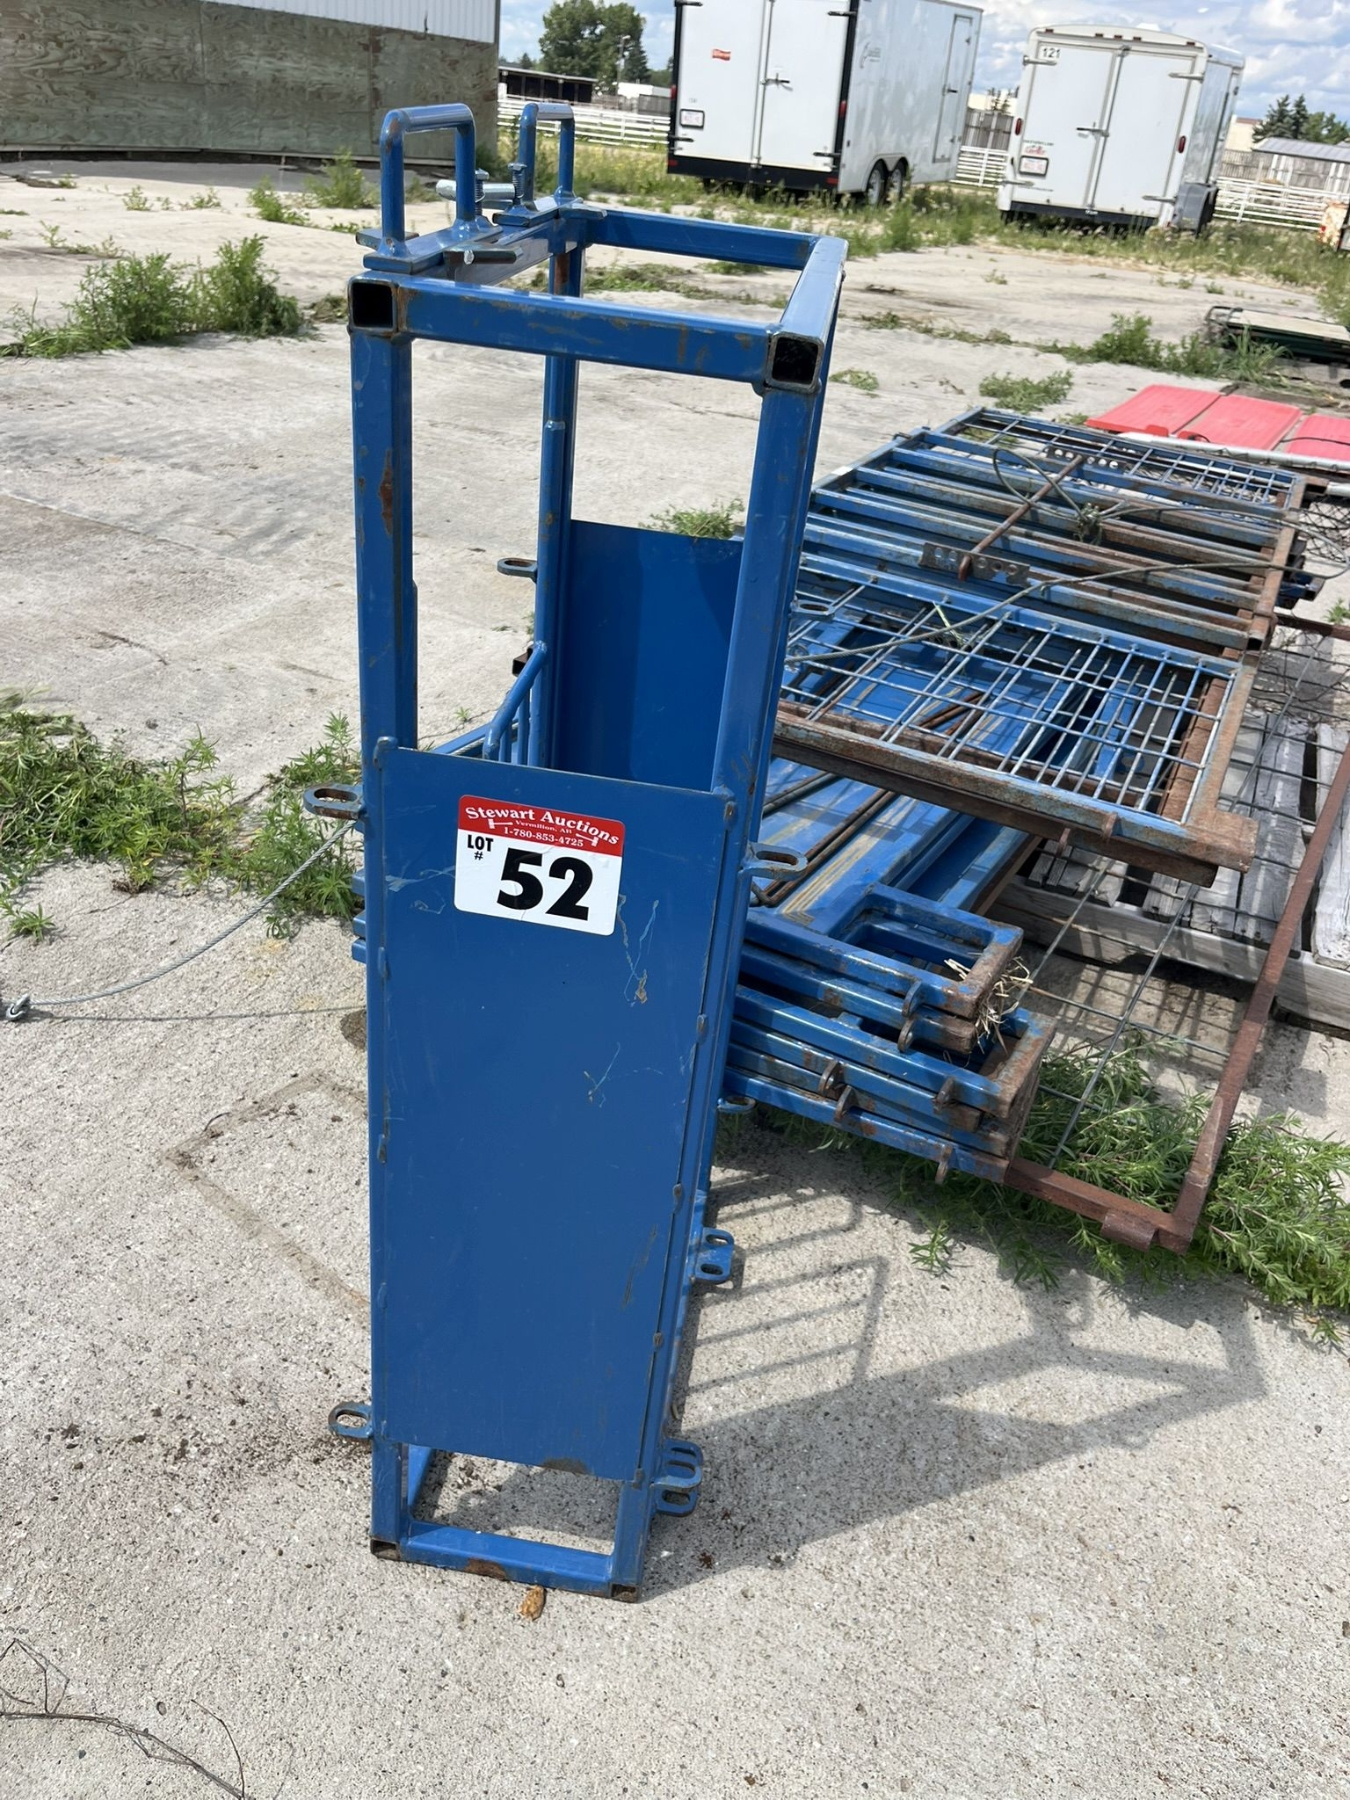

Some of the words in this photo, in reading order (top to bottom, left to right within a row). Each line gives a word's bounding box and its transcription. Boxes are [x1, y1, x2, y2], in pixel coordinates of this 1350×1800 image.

[1043, 47, 1060, 58] 121
[465, 807, 535, 820] Stewart
[541, 811, 619, 844] Auctions
[467, 834, 494, 851] LOT
[504, 827, 583, 847] 1-780-853-4725
[474, 851, 483, 860] #
[496, 847, 593, 921] 52
